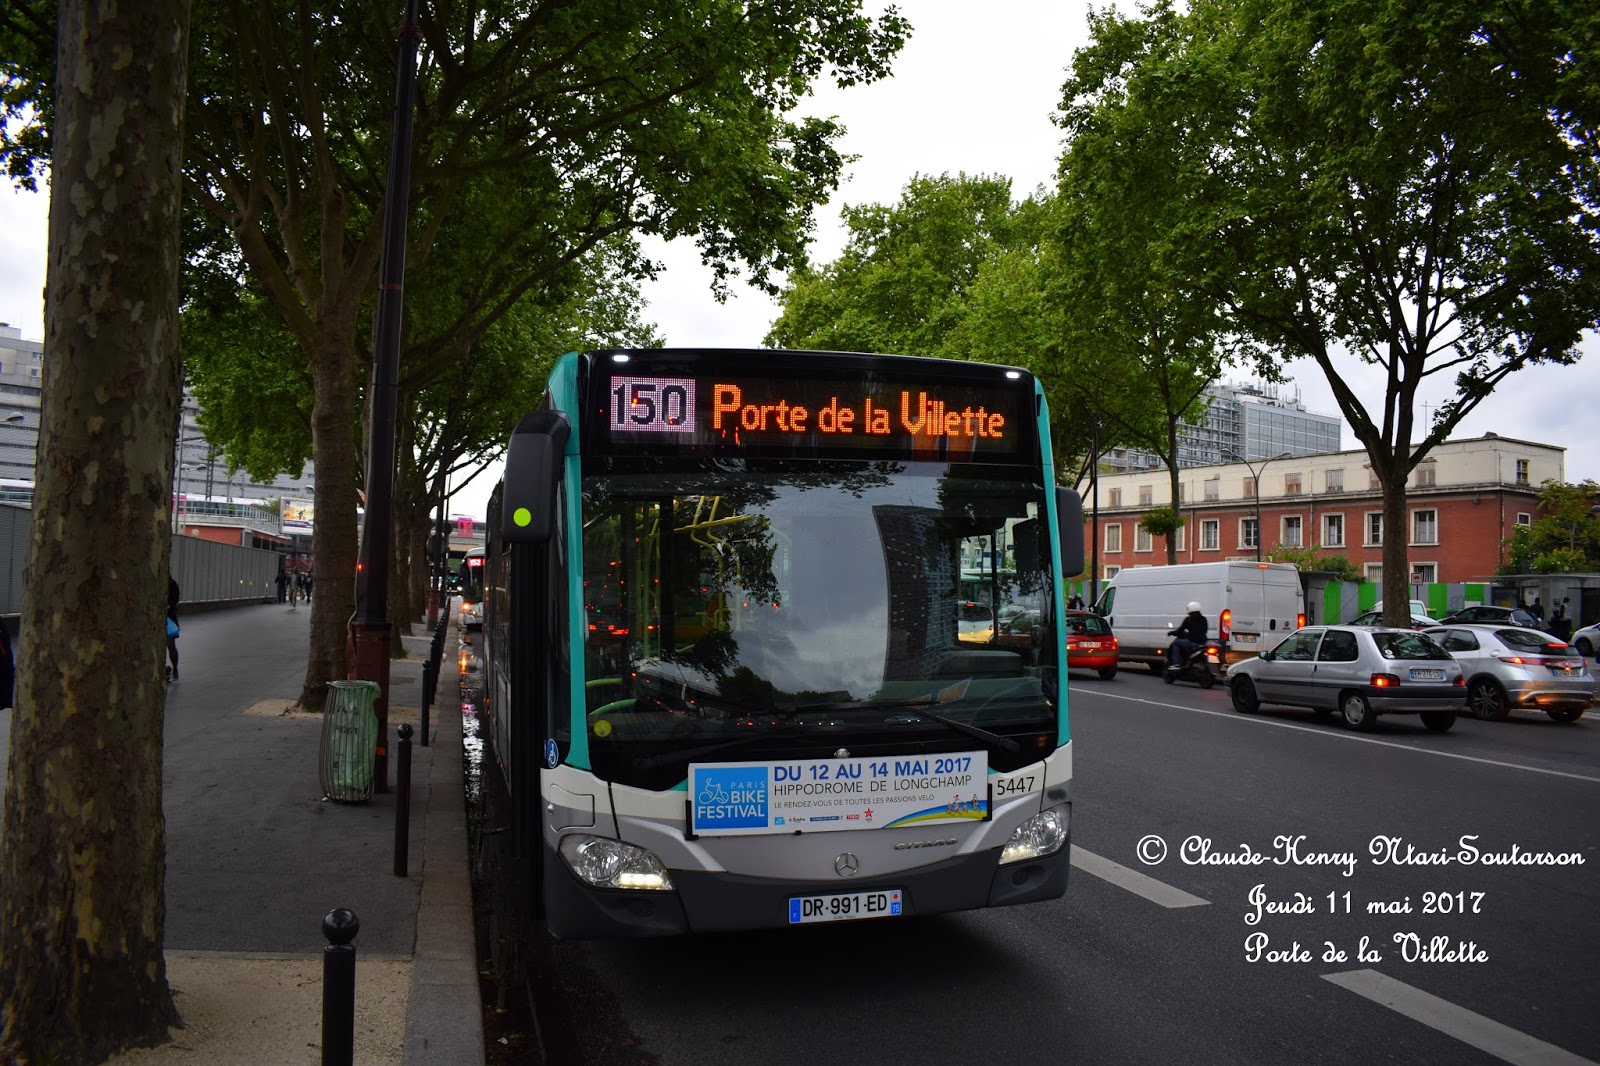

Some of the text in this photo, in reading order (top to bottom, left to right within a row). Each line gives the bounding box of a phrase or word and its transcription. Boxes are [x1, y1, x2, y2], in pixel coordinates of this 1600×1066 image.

[612, 382, 687, 426] 150
[713, 383, 1005, 438] Porte de la Villette
[774, 757, 972, 781] DU 12 AU 14 MAI 2017
[730, 781, 766, 789] PARIS
[774, 775, 972, 796] HIPPODROME DE LONGCHAMP
[997, 776, 1035, 796] 5447
[731, 790, 766, 804] BIKE
[774, 801, 783, 809] LE
[783, 799, 833, 808] RENDEZ-VOUS
[833, 798, 844, 806] DE
[845, 797, 872, 806] TOUTES
[872, 796, 885, 804] LES
[885, 794, 918, 803] PASSIONS
[697, 804, 766, 819] FESTIVAL
[803, 894, 888, 917] DR-991-ED
[891, 904, 900, 913] 75
